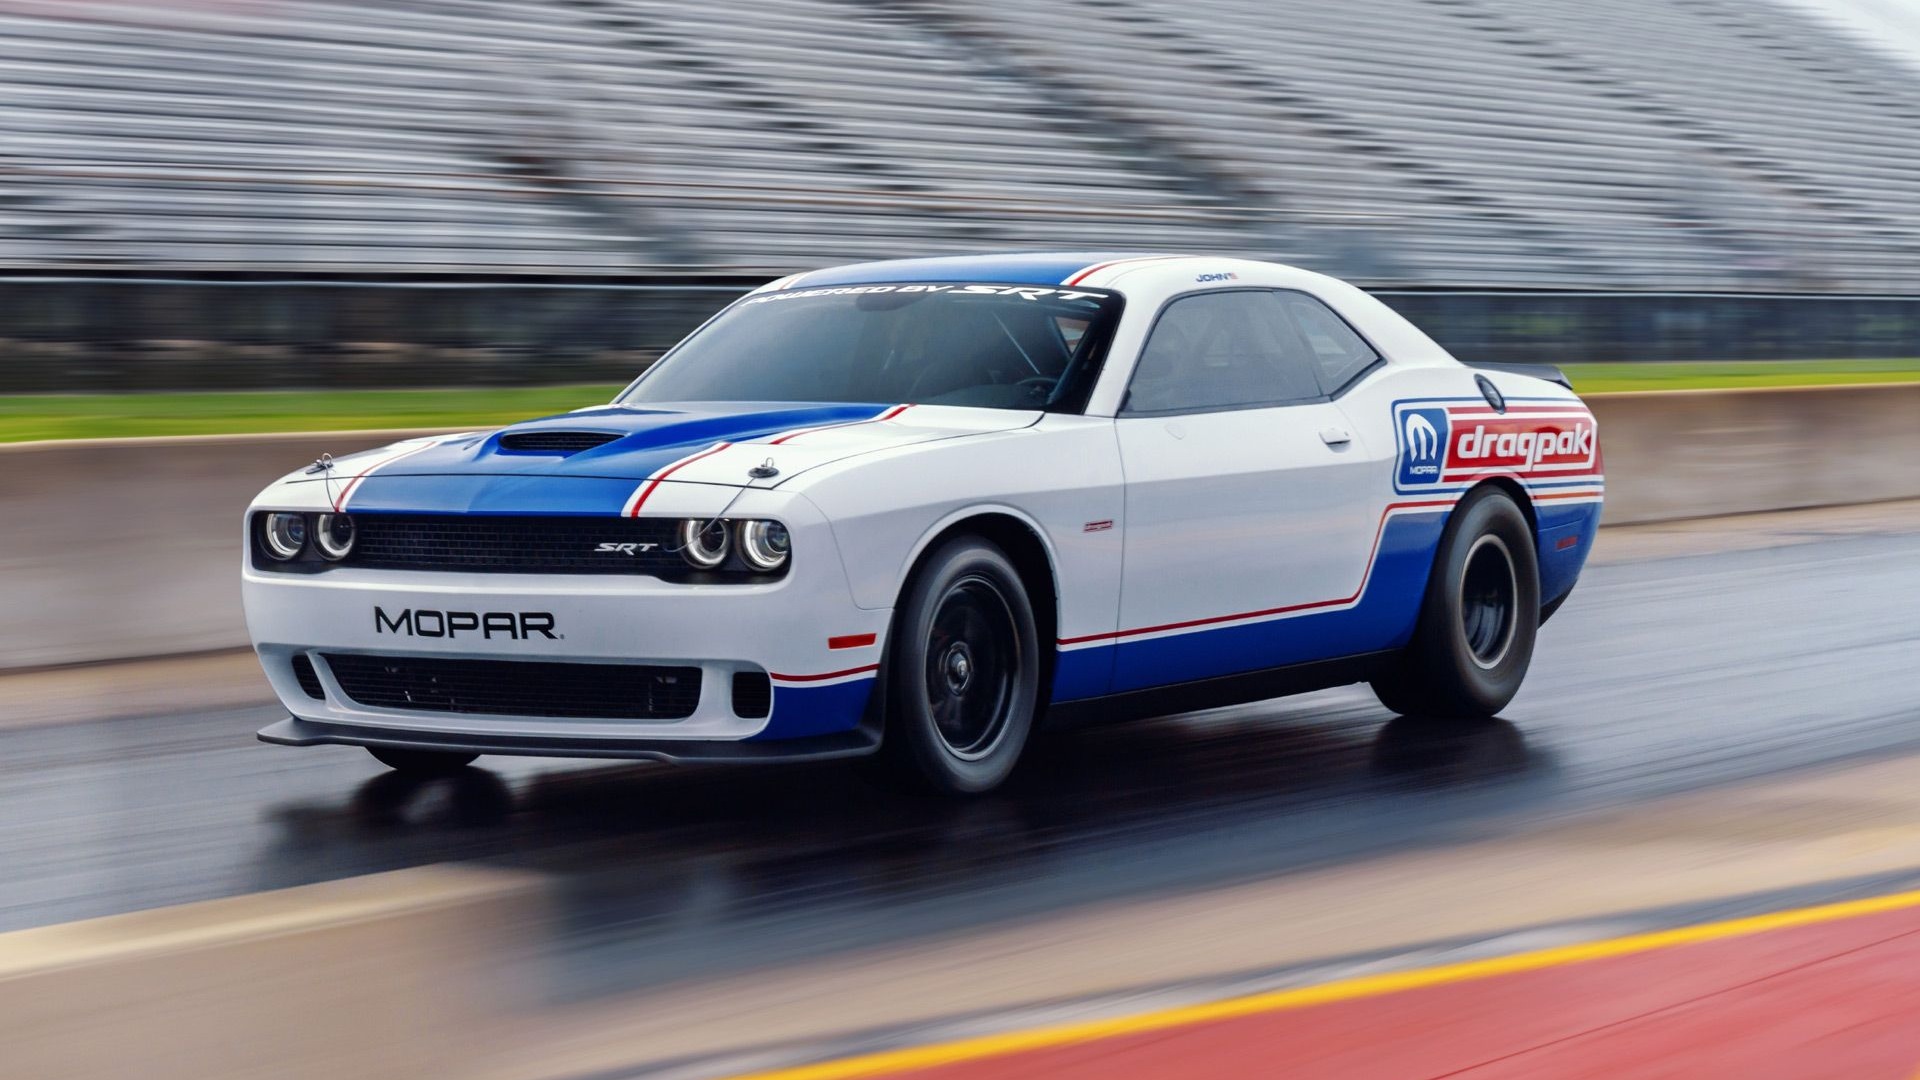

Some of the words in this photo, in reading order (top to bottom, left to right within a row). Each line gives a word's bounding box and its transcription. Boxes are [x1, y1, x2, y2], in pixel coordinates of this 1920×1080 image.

[1195, 272, 1230, 282] JOHN
[740, 286, 897, 306] POWERED
[895, 285, 955, 293] BY
[947, 285, 1109, 301] SRT
[1457, 423, 1591, 472] dragpak
[1409, 465, 1439, 475] MOPAR
[594, 542, 659, 556] SRT
[374, 605, 559, 640] MOPAR
